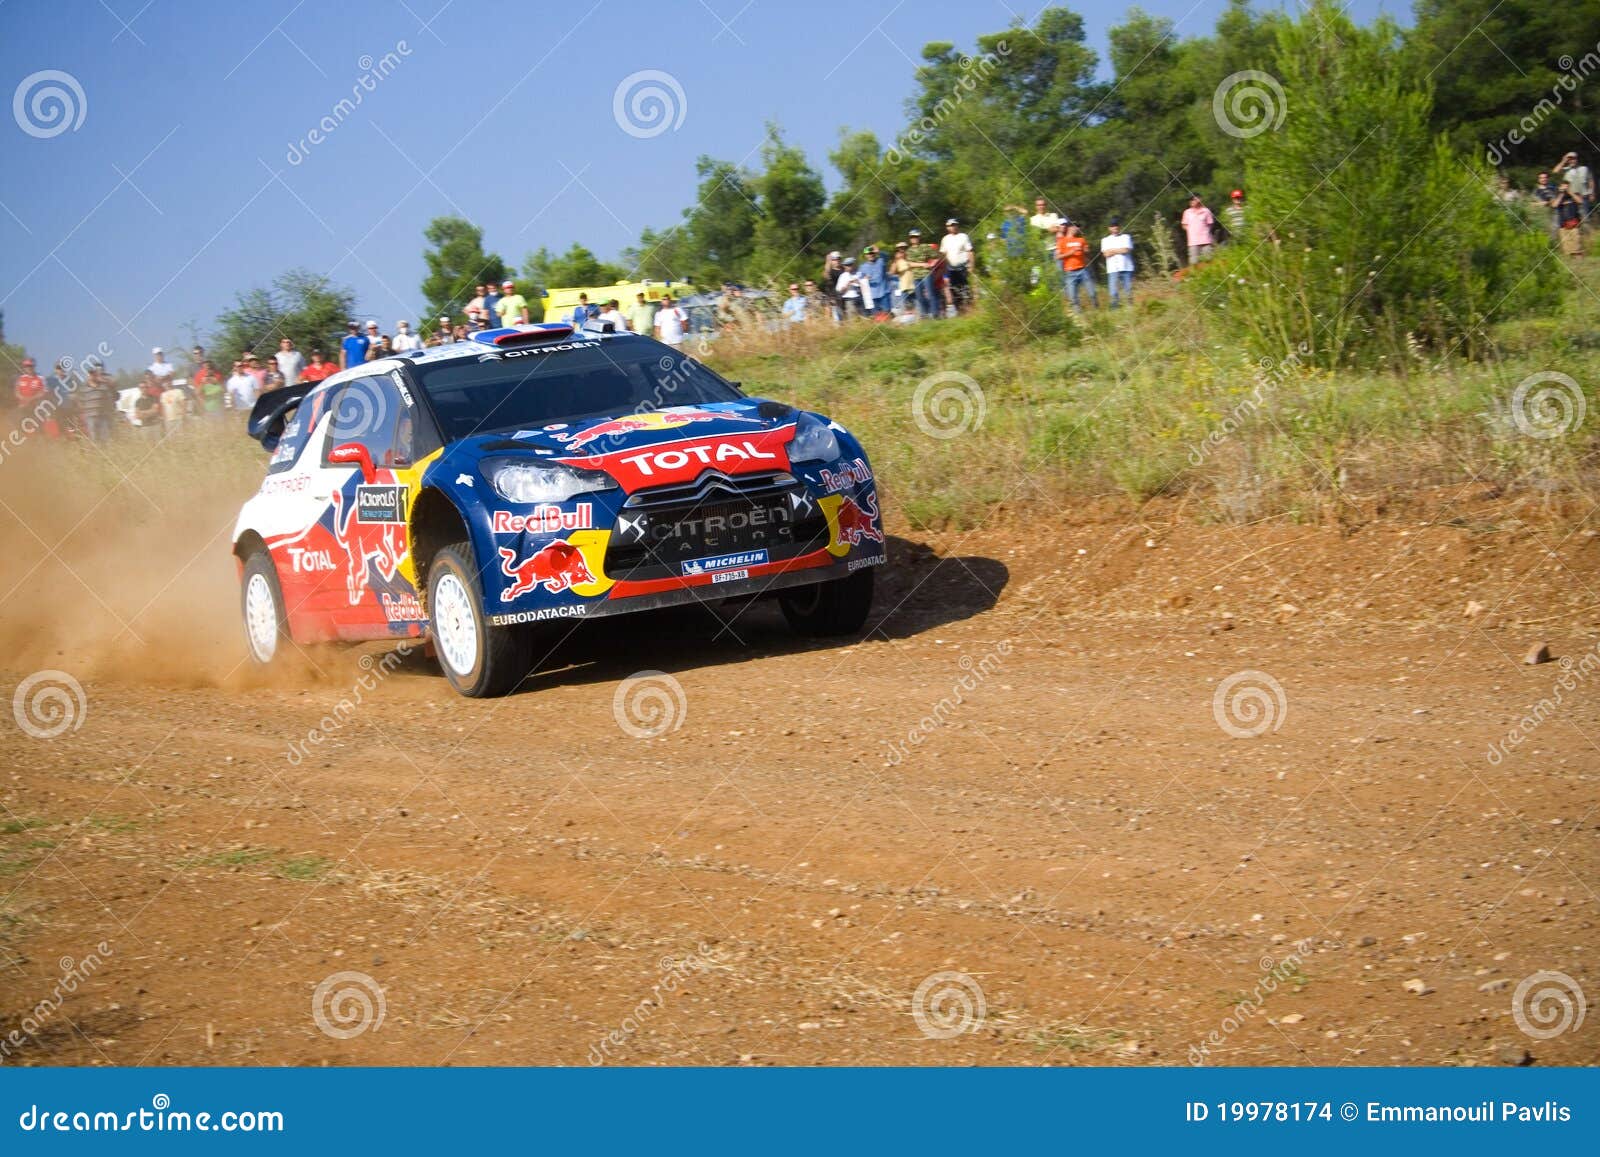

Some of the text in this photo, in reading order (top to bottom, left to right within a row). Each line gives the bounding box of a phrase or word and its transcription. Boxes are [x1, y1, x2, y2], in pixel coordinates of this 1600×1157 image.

[620, 441, 775, 476] TOTAL
[288, 547, 337, 573] TOTAL
[704, 552, 764, 569] MICHELIN
[493, 605, 586, 626] EURODATACAR
